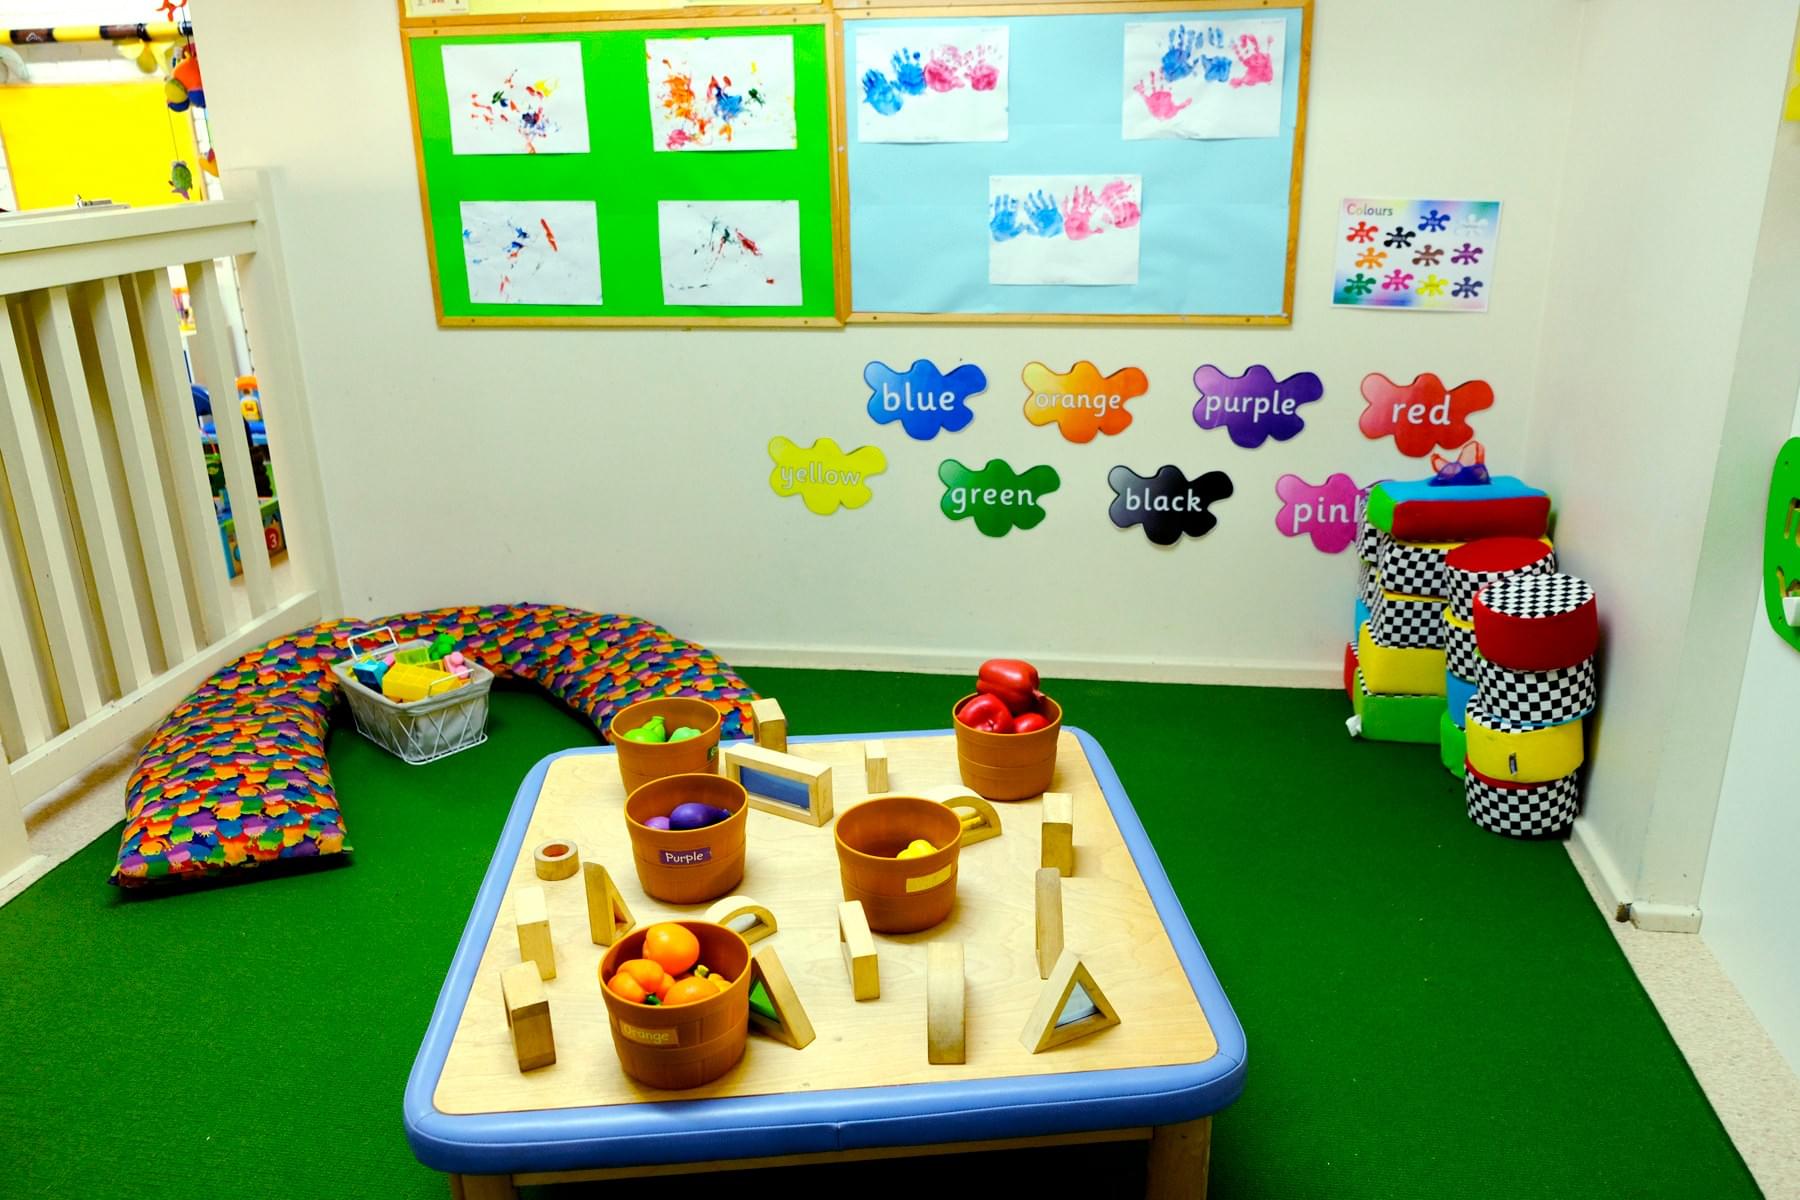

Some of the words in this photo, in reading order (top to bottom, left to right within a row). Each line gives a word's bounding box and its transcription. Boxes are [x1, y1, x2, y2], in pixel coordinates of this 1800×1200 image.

[1347, 203, 1393, 216] Colours
[882, 382, 956, 412] blue
[1035, 392, 1121, 416] orange
[1204, 390, 1297, 423] purple
[1391, 394, 1451, 425] red
[780, 462, 861, 489] yellow
[951, 486, 1034, 513] green
[1125, 487, 1203, 513] black
[269, 533, 278, 549] 3
[665, 850, 704, 864] Purple
[623, 1023, 671, 1045] Orange
